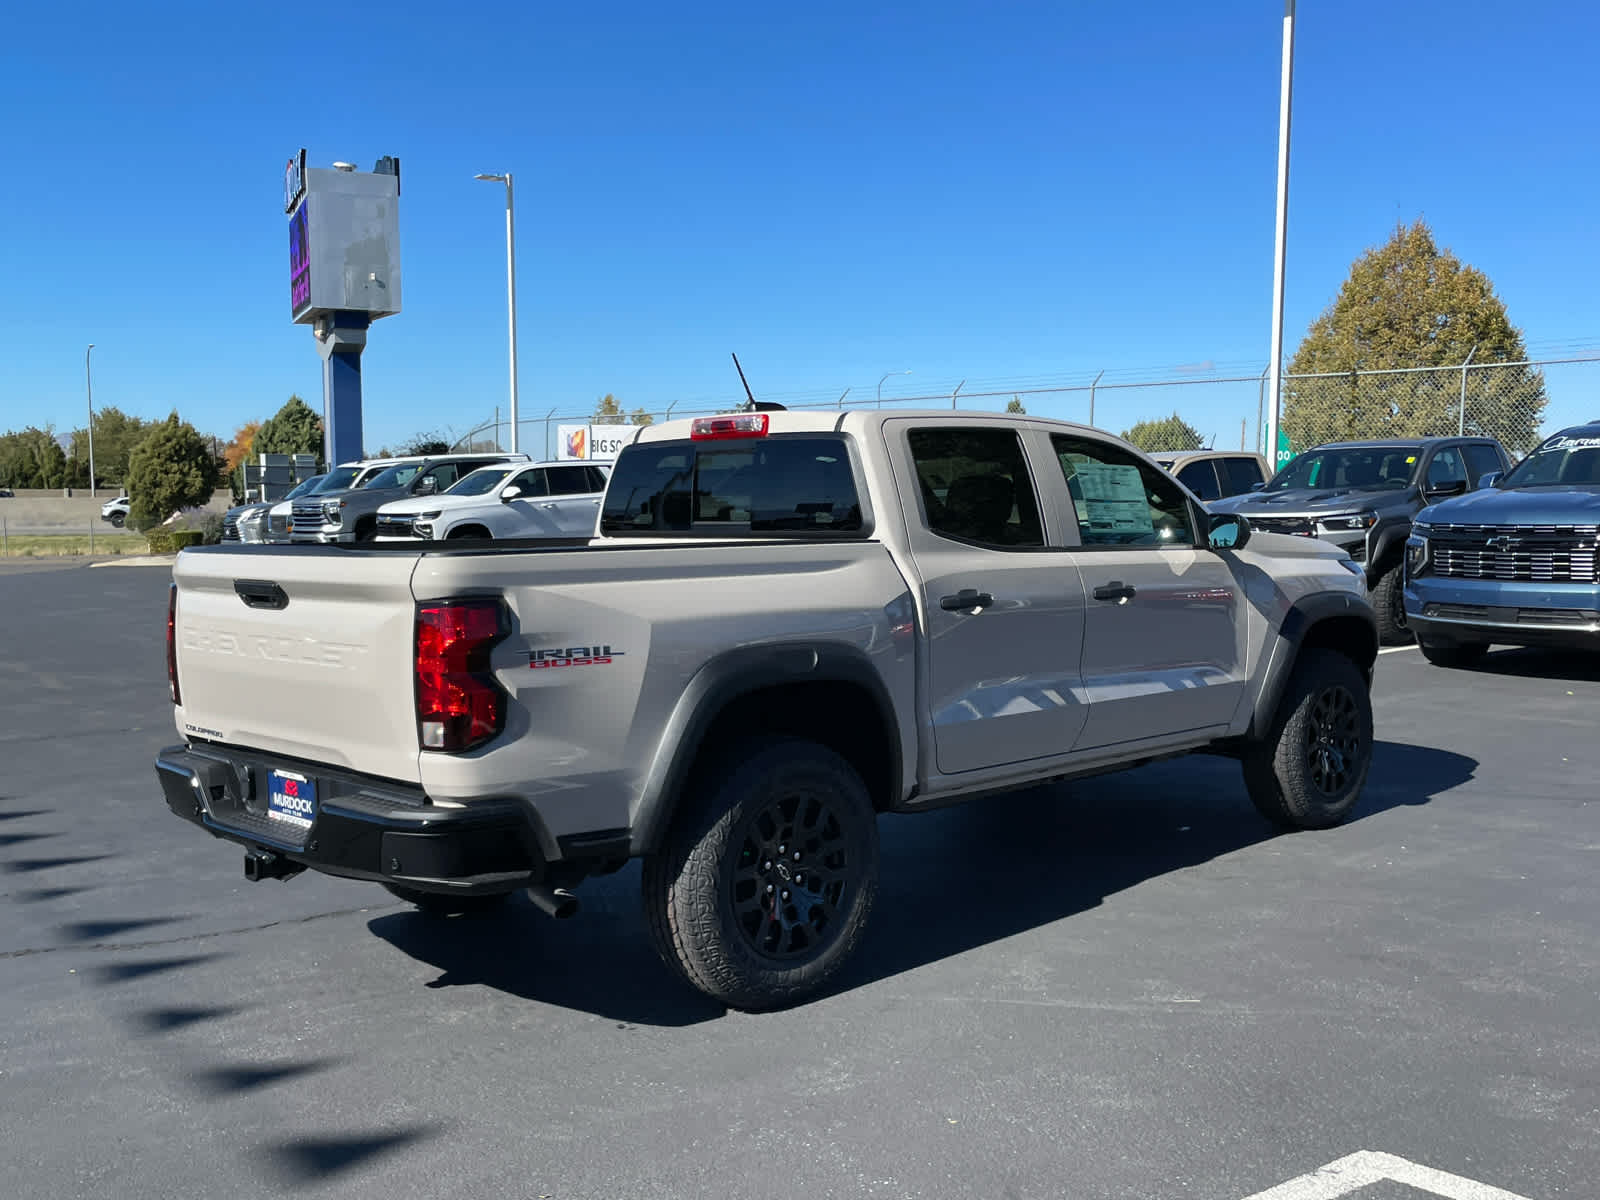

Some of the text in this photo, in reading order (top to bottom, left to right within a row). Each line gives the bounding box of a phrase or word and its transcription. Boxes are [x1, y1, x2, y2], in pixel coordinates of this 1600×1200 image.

[591, 439, 608, 453] BIG
[515, 645, 625, 661] TRAIL
[529, 656, 612, 669] BOSS
[273, 791, 313, 814] MURDOCK
